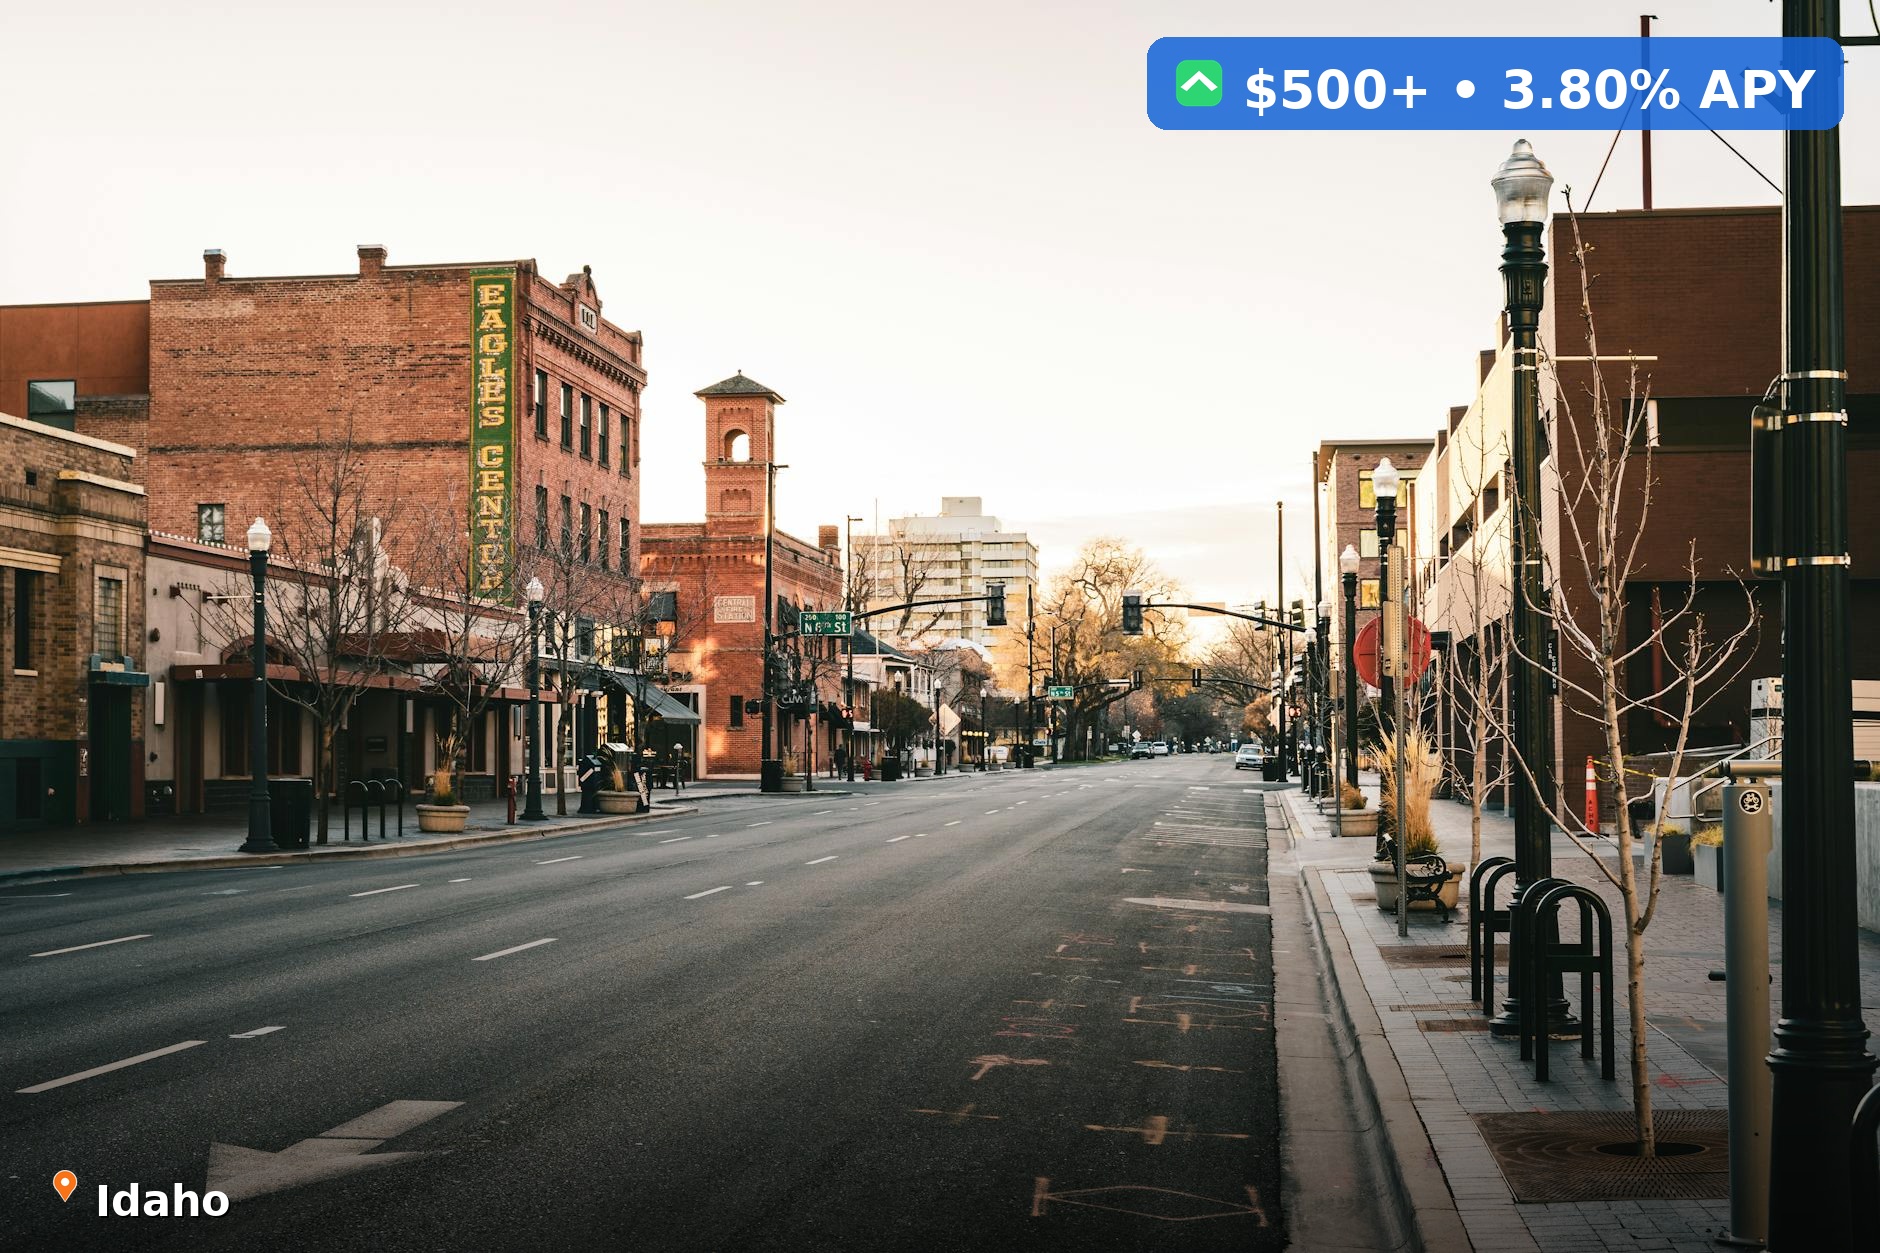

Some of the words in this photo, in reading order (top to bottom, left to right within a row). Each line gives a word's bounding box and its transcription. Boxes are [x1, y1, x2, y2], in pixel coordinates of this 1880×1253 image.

[478, 283, 509, 428] EAGLES
[715, 611, 753, 621] STATION
[804, 622, 813, 633] N
[834, 621, 847, 633] St
